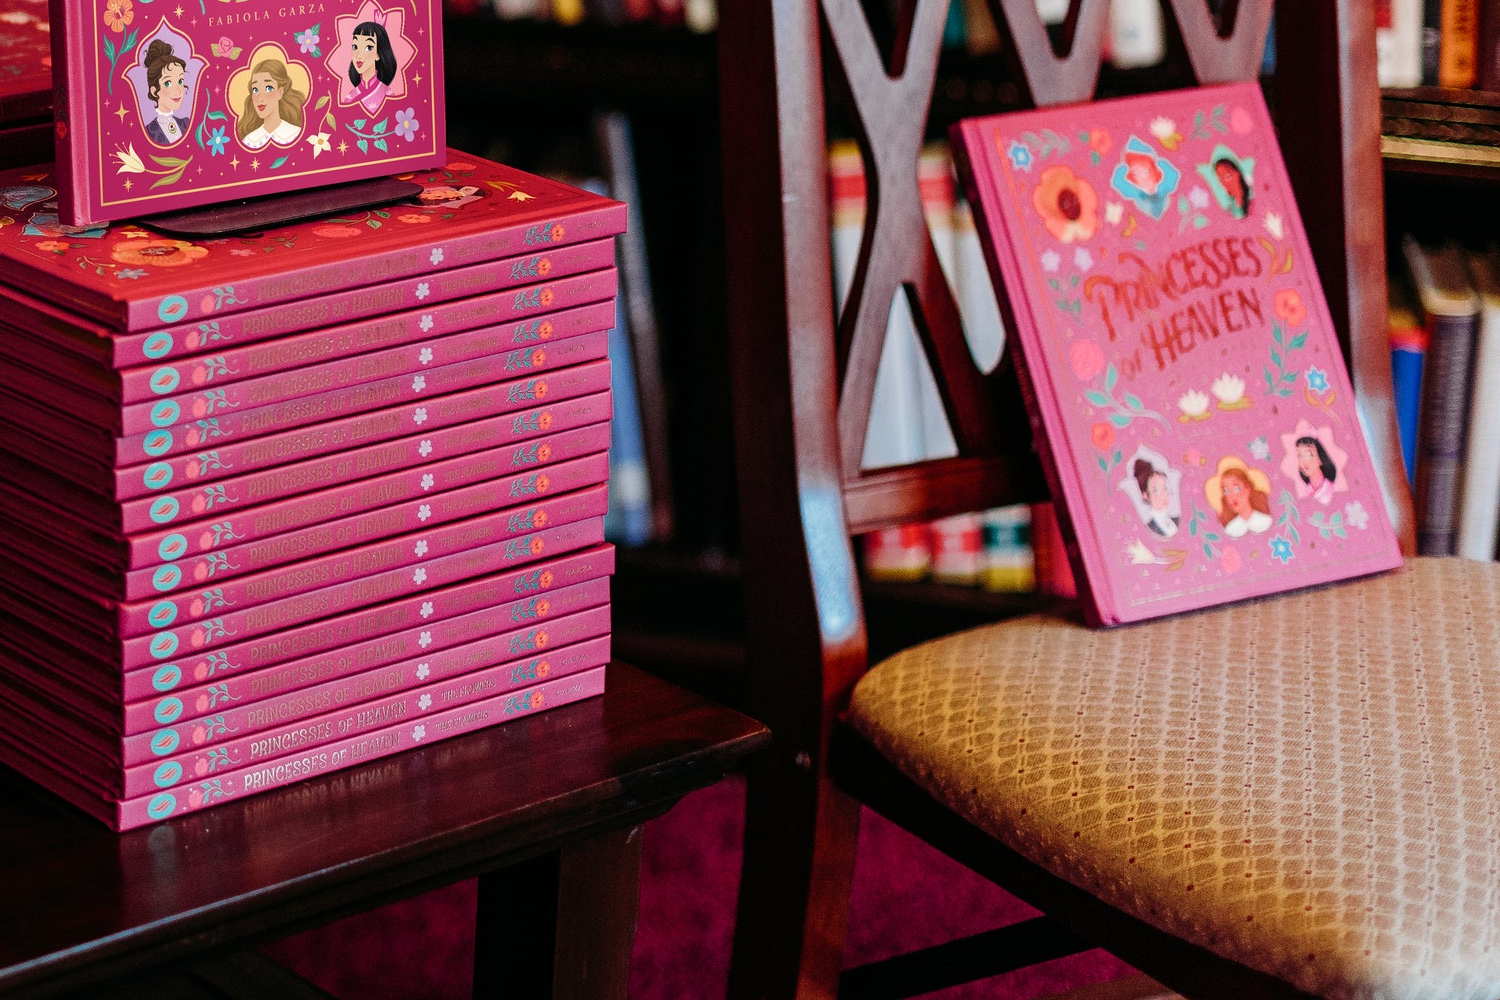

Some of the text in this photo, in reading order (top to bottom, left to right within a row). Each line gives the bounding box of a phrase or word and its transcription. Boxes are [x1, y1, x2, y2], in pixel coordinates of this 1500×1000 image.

[207, 2, 326, 28] FABIOLA GARZA
[1083, 236, 1264, 345] PRINCESSES
[1141, 287, 1265, 372] HEAVEN
[249, 508, 406, 565] PRINCESSES OF HEAVEN
[438, 523, 494, 550] THE FLOWERS
[245, 544, 403, 601] PRINCESSES OF HEAVEN
[564, 563, 592, 578] GARZA
[246, 668, 405, 729] PRINCESSES OF HEAVEN
[441, 676, 496, 703] THE FLOWERS
[249, 698, 407, 760] PRINCESSES OF HEAVEN
[243, 731, 400, 792] PRINCESSES OF HEAVEN
